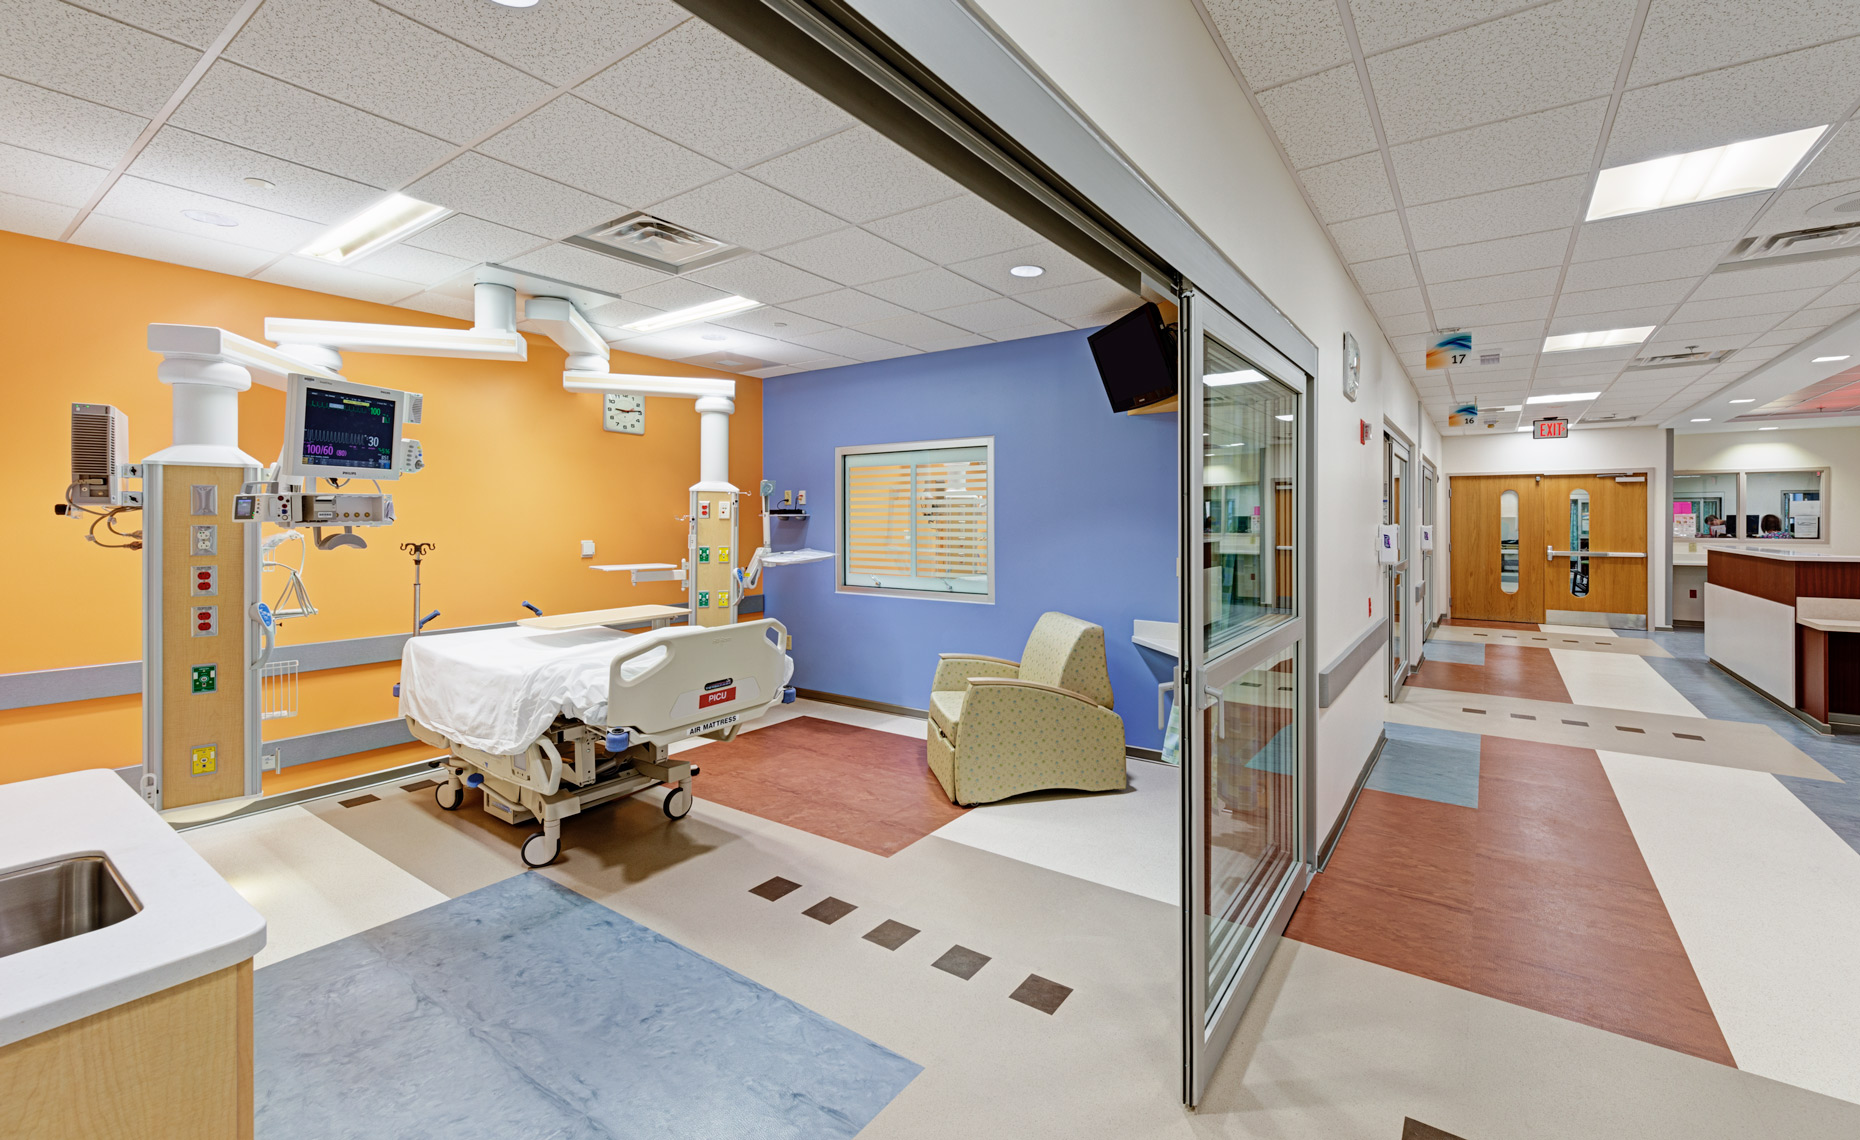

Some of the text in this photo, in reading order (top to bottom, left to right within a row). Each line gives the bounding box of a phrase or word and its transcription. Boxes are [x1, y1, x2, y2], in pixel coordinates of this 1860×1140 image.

[1451, 354, 1466, 364] 17
[370, 407, 381, 416] 100
[1540, 422, 1563, 437] EXIT
[368, 436, 379, 447] 30
[307, 444, 334, 455] 100/60
[708, 691, 727, 702] PICU
[690, 716, 736, 735] AIR MATTRESS
